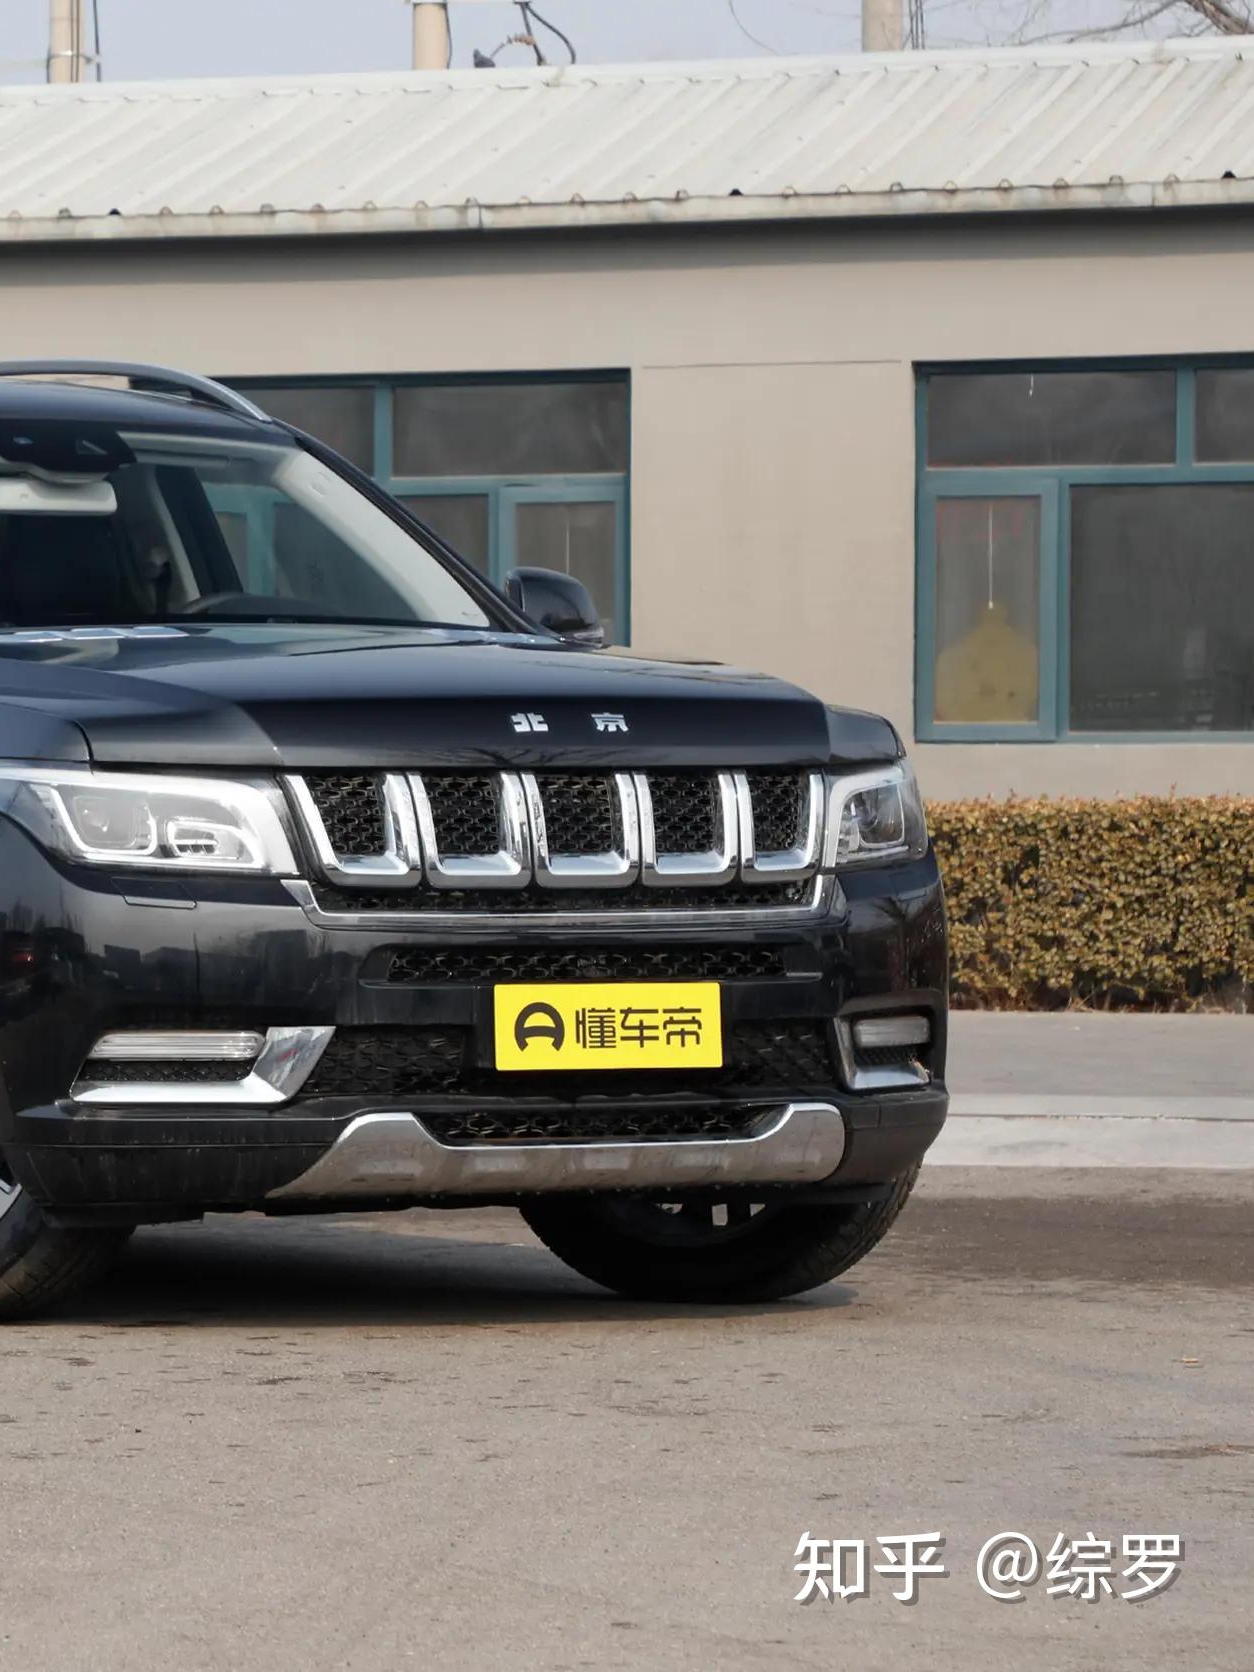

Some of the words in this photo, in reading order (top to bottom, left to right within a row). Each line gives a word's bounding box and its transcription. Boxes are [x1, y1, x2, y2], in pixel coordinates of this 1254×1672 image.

[510, 712, 629, 732] 北京
[575, 1006, 703, 1049] 懂车帝
